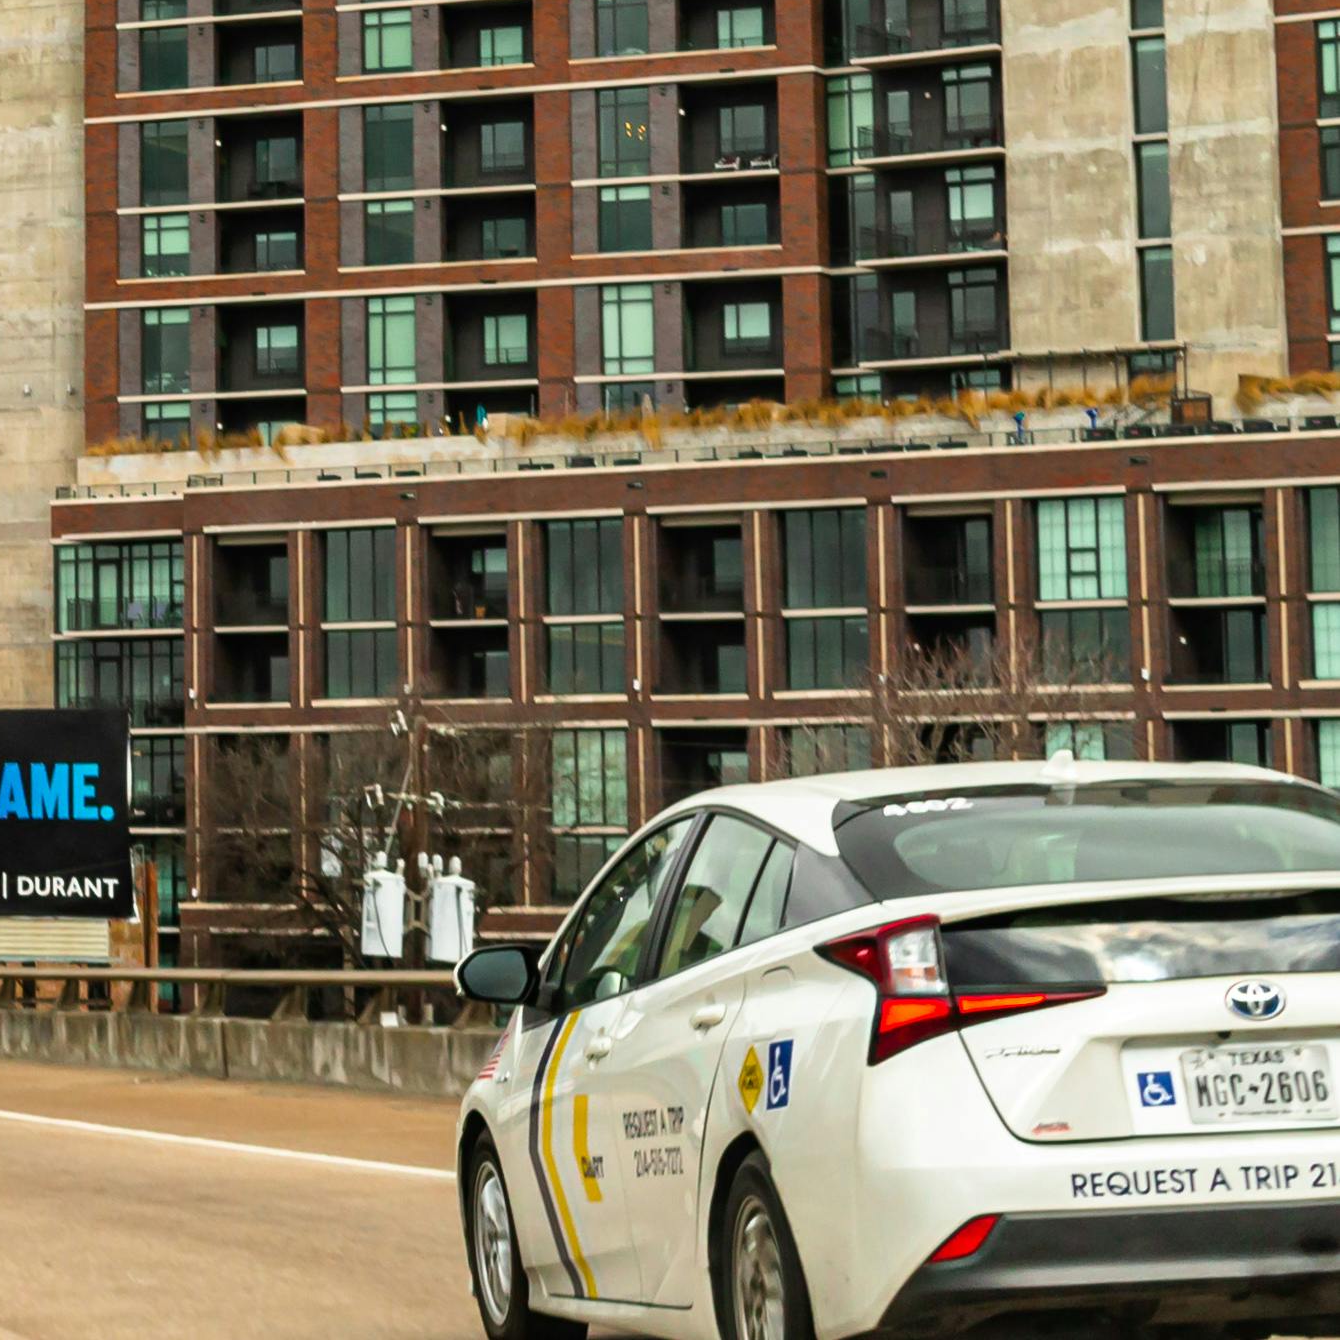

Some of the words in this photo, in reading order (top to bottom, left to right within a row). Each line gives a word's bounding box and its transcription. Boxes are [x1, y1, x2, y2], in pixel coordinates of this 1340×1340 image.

[16, 875, 120, 900] DURANT
[1227, 1049, 1285, 1066] TEXAS
[1070, 1167, 1199, 1199] REQUEST
[1209, 1166, 1232, 1193] A
[1239, 1163, 1299, 1191] TRIP
[1309, 1162, 1340, 1188] 21
